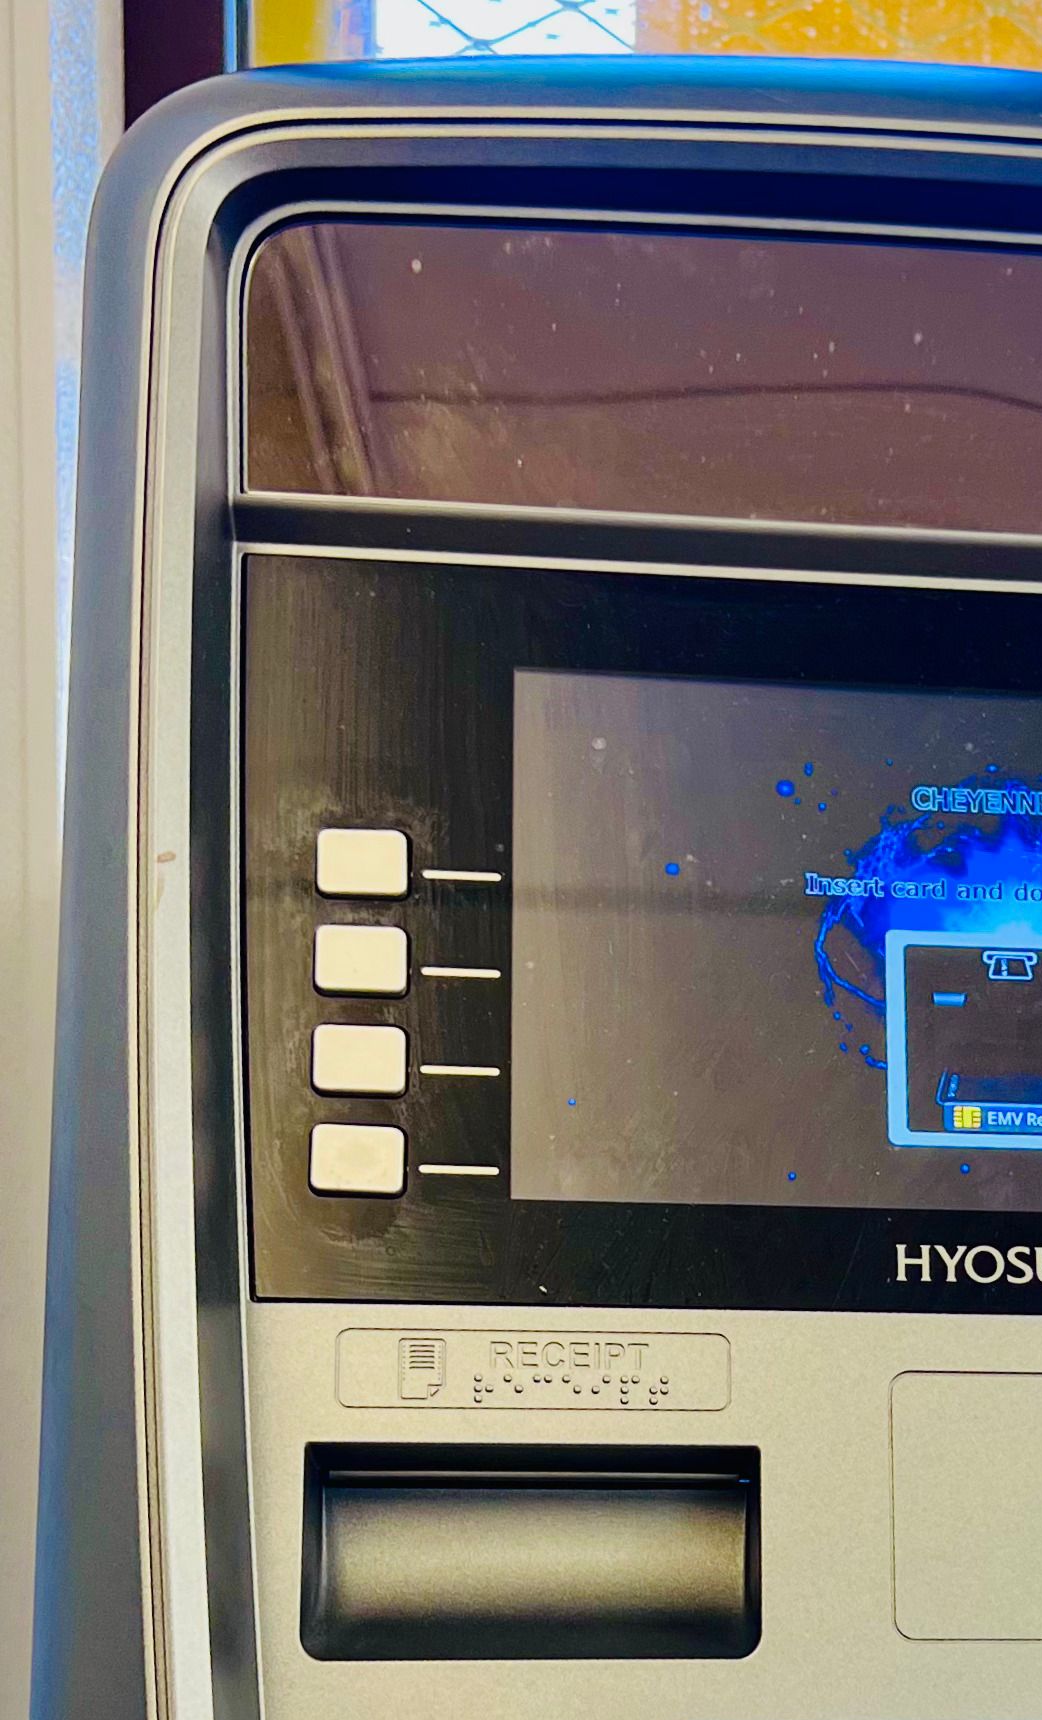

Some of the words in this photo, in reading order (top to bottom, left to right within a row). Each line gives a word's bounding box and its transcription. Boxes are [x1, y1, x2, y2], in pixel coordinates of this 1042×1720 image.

[804, 872, 885, 897] Insert
[890, 879, 947, 900] card
[956, 881, 1002, 902] and
[987, 1111, 1023, 1127] EMV
[489, 1340, 650, 1370] RECEIPT
